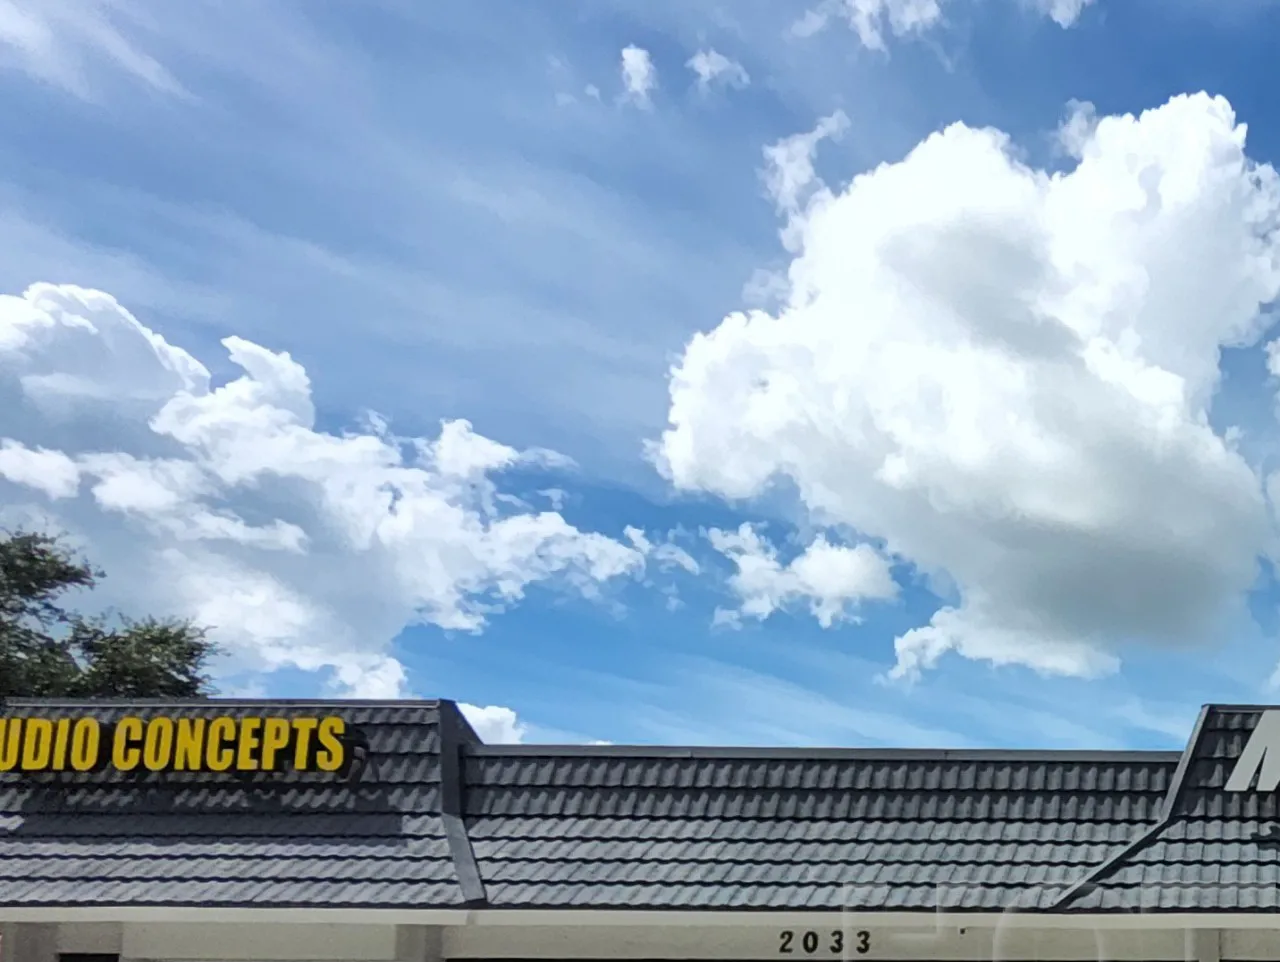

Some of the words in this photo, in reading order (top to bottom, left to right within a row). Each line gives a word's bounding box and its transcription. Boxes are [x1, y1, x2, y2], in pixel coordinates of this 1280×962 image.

[0, 716, 101, 771] UDIO
[111, 715, 346, 772] CONCEPTS
[779, 930, 872, 954] 2033
